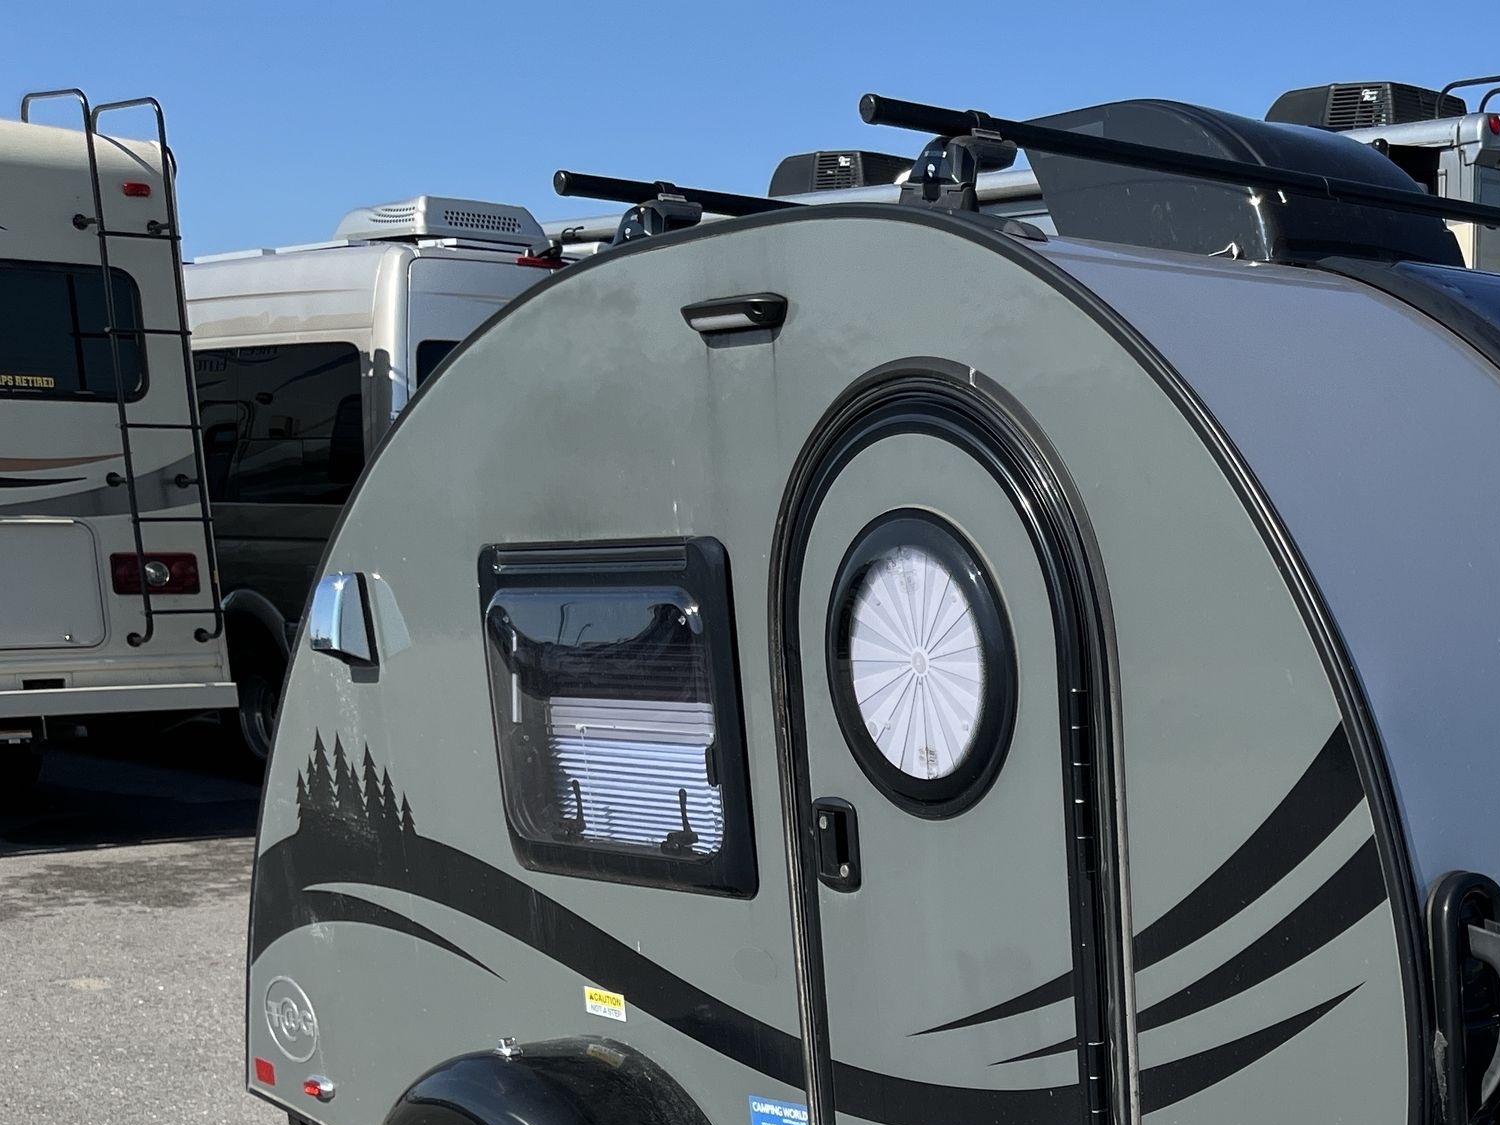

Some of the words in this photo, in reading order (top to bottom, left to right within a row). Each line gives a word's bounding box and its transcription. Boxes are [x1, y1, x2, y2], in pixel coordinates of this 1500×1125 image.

[15, 375, 55, 388] RETIRED
[593, 992, 622, 1006] CAUTION
[752, 1101, 783, 1117] CAMPING
[782, 1107, 808, 1121] WORLD
